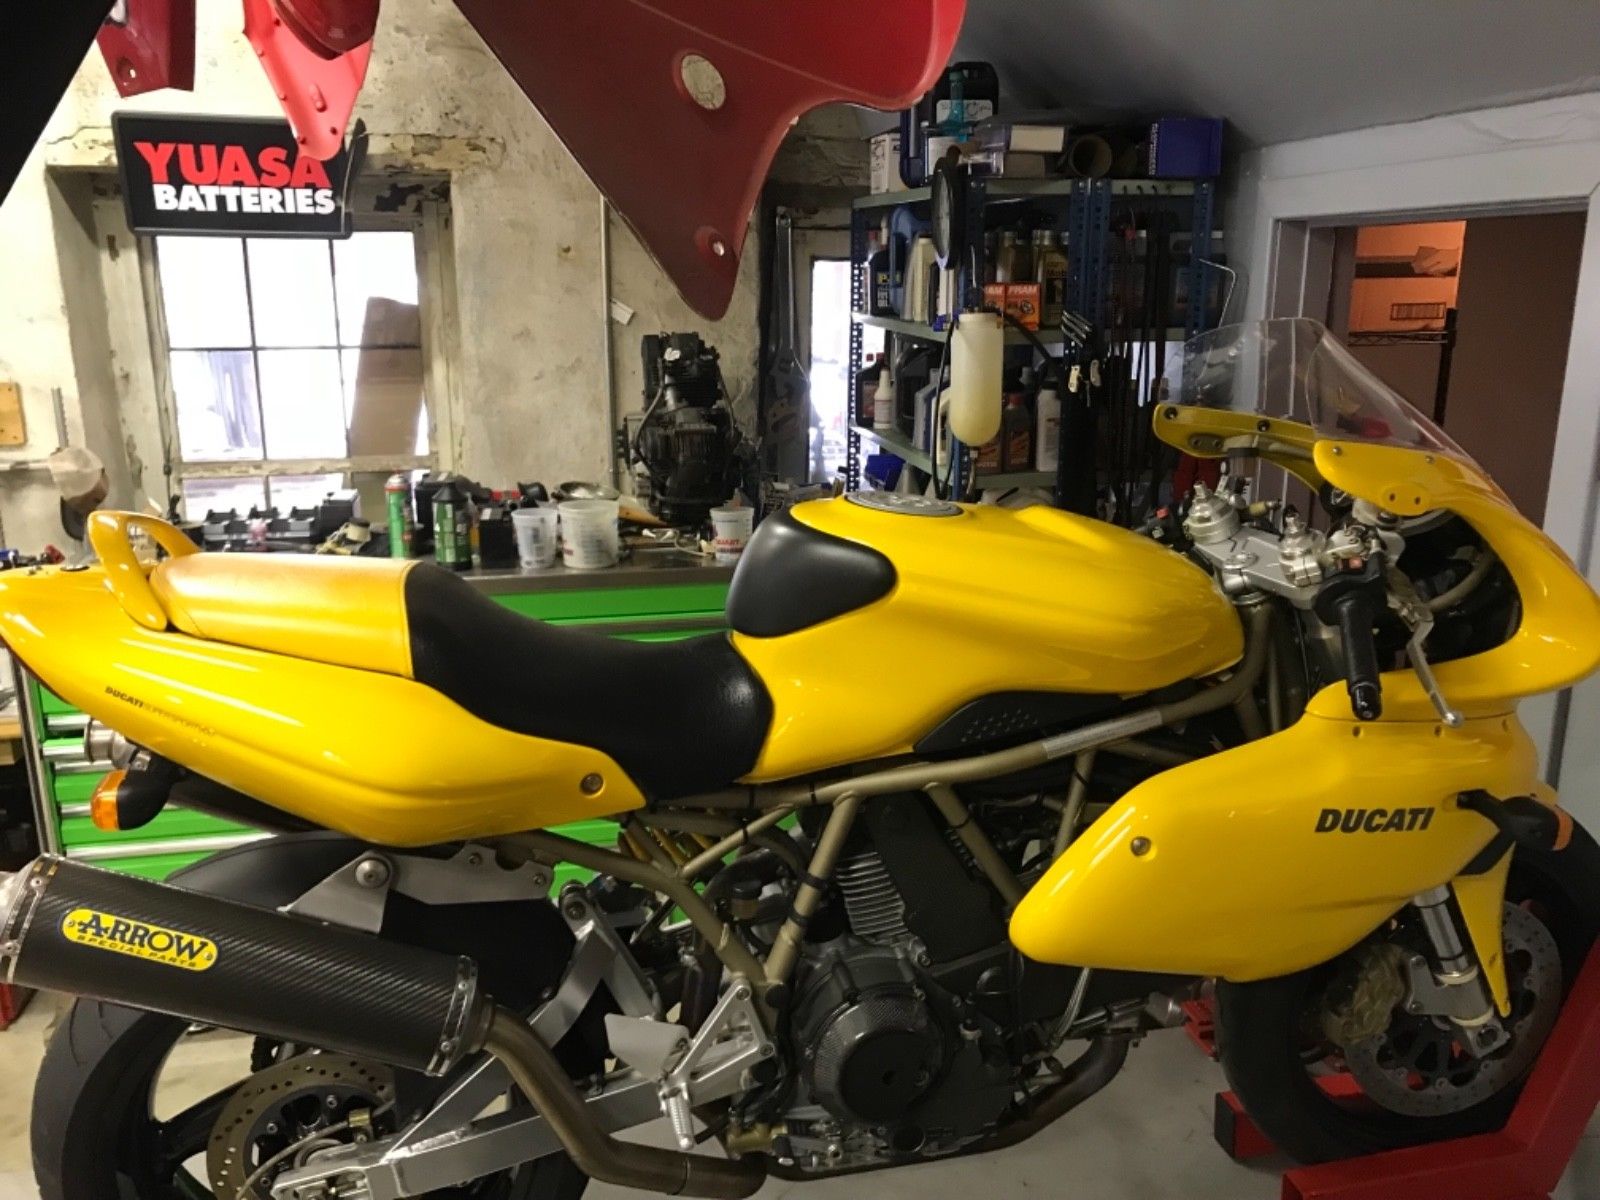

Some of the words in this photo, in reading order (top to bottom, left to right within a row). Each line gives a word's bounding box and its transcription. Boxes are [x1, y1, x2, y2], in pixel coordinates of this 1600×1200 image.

[133, 141, 332, 188] YUASA
[153, 184, 336, 214] BATTERIES
[105, 686, 144, 708] DUCATI
[1314, 807, 1435, 833] DUCATI
[77, 914, 208, 960] ARROW
[77, 934, 143, 956] SPECIAL
[148, 951, 197, 968] PARTS
